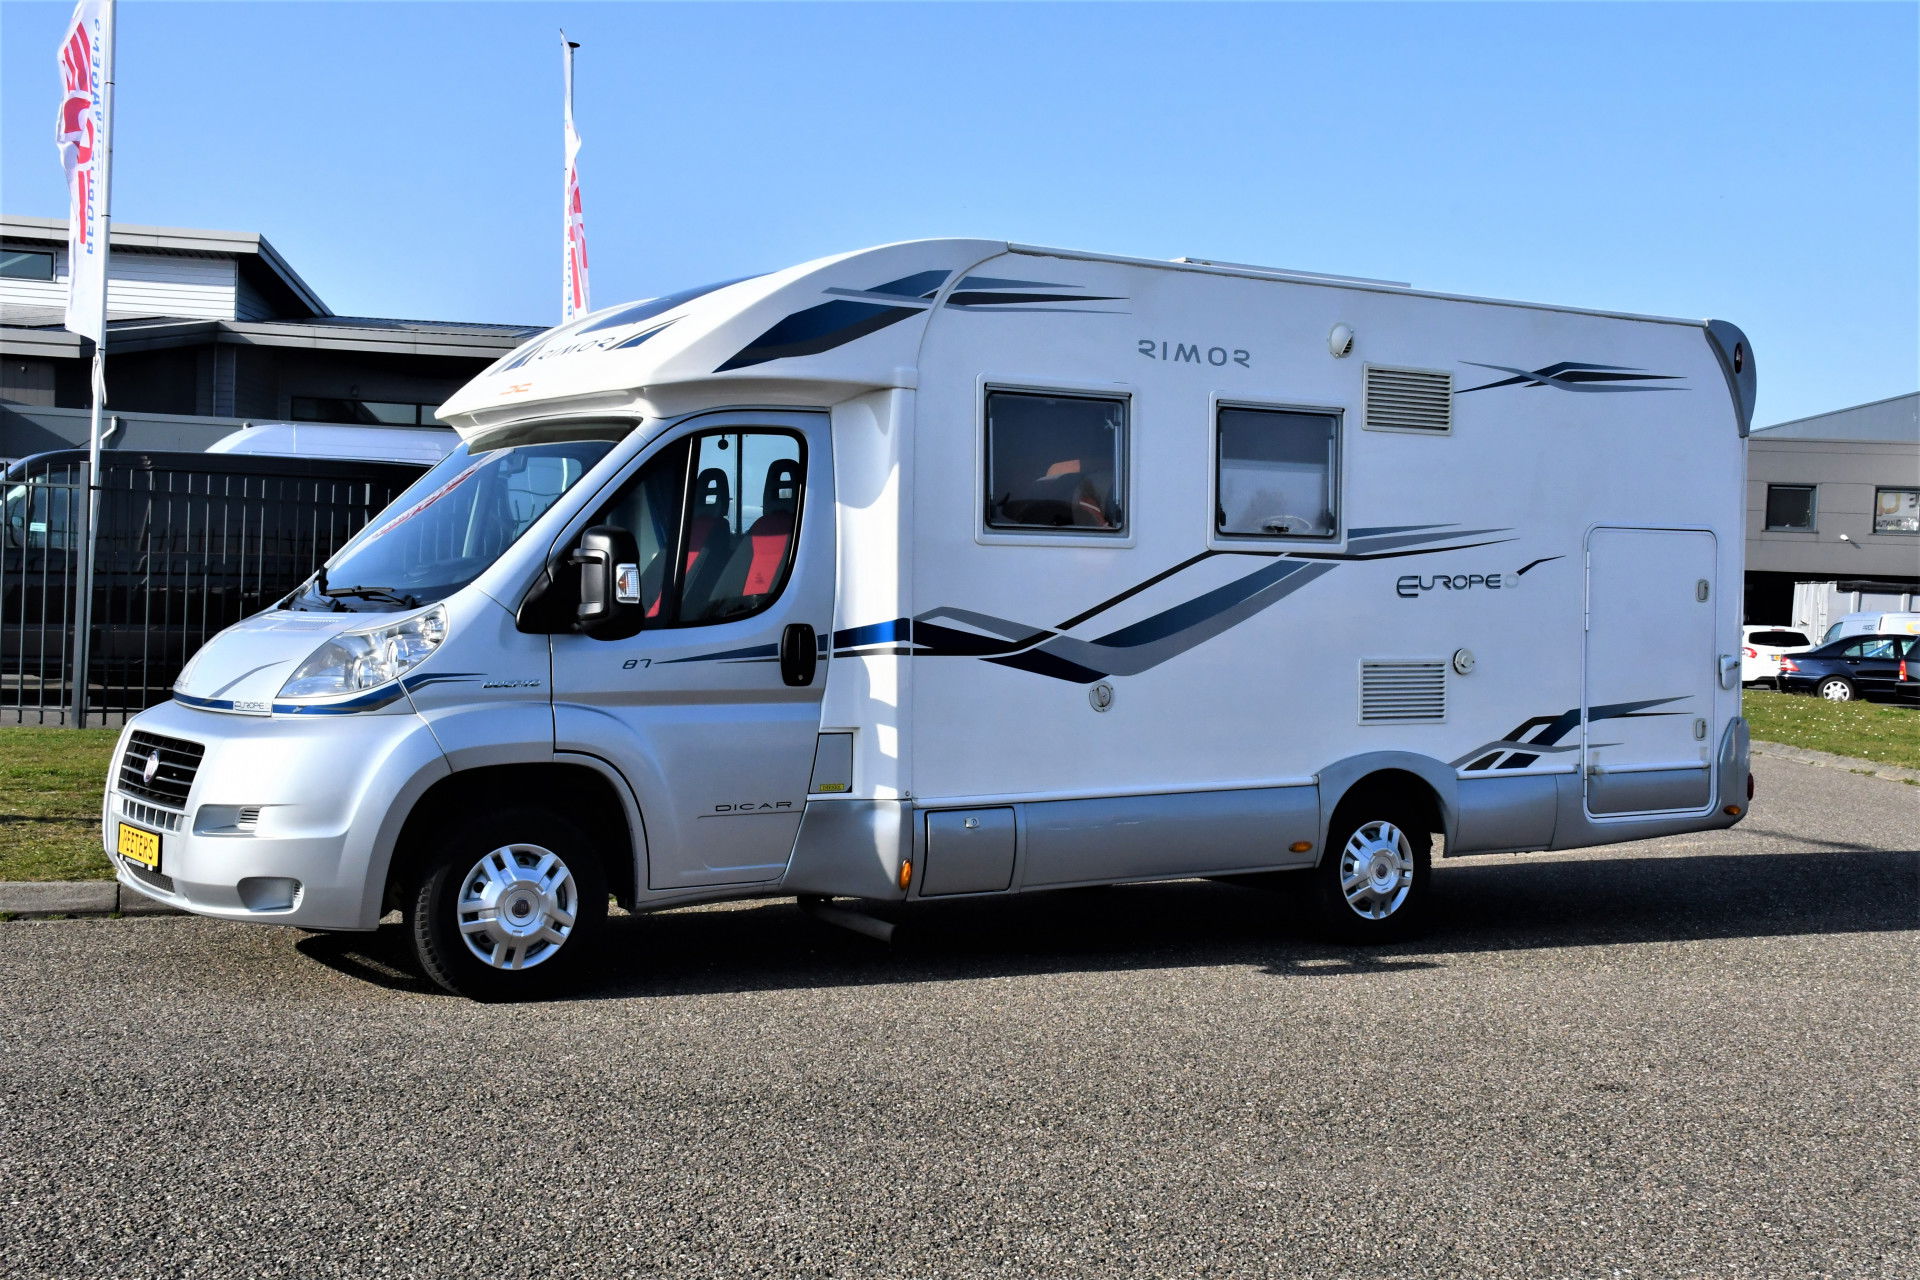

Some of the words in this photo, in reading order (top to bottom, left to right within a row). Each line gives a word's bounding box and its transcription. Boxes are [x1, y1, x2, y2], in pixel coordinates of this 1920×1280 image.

[1138, 339, 1250, 369] RIMOR
[622, 658, 652, 670] 87
[234, 700, 270, 712] EUROPE
[715, 801, 793, 812] DICAR
